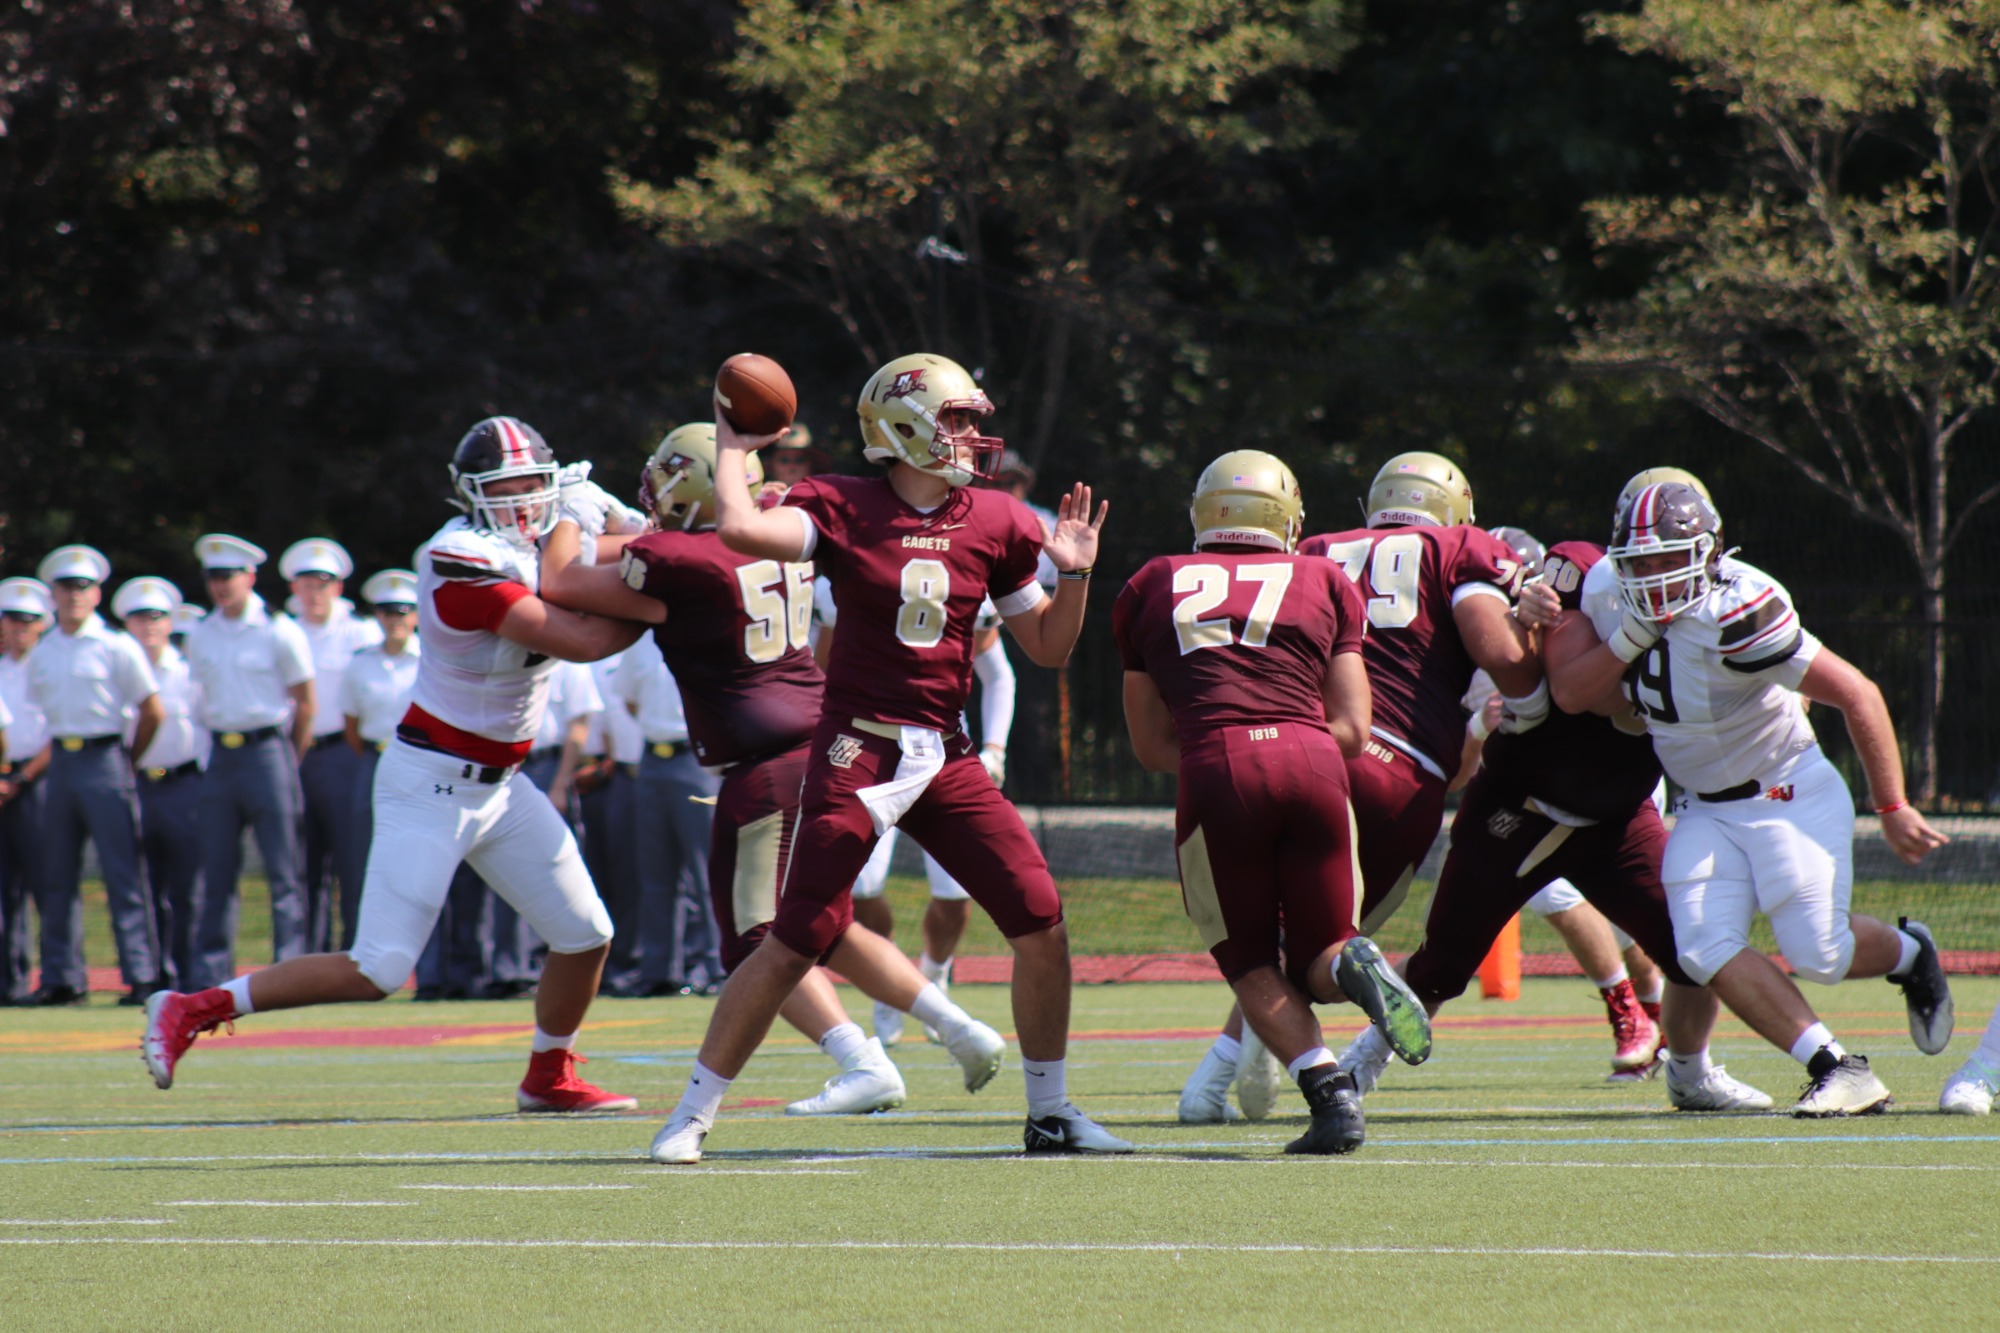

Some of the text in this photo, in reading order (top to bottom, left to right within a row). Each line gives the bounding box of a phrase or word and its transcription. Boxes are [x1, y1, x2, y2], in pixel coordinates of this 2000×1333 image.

[901, 535, 951, 551] CADETS
[735, 559, 815, 663] 56
[895, 558, 950, 648] 8
[1172, 562, 1294, 656] 27
[1248, 727, 1279, 741] 1819
[1364, 740, 1395, 764] 1819
